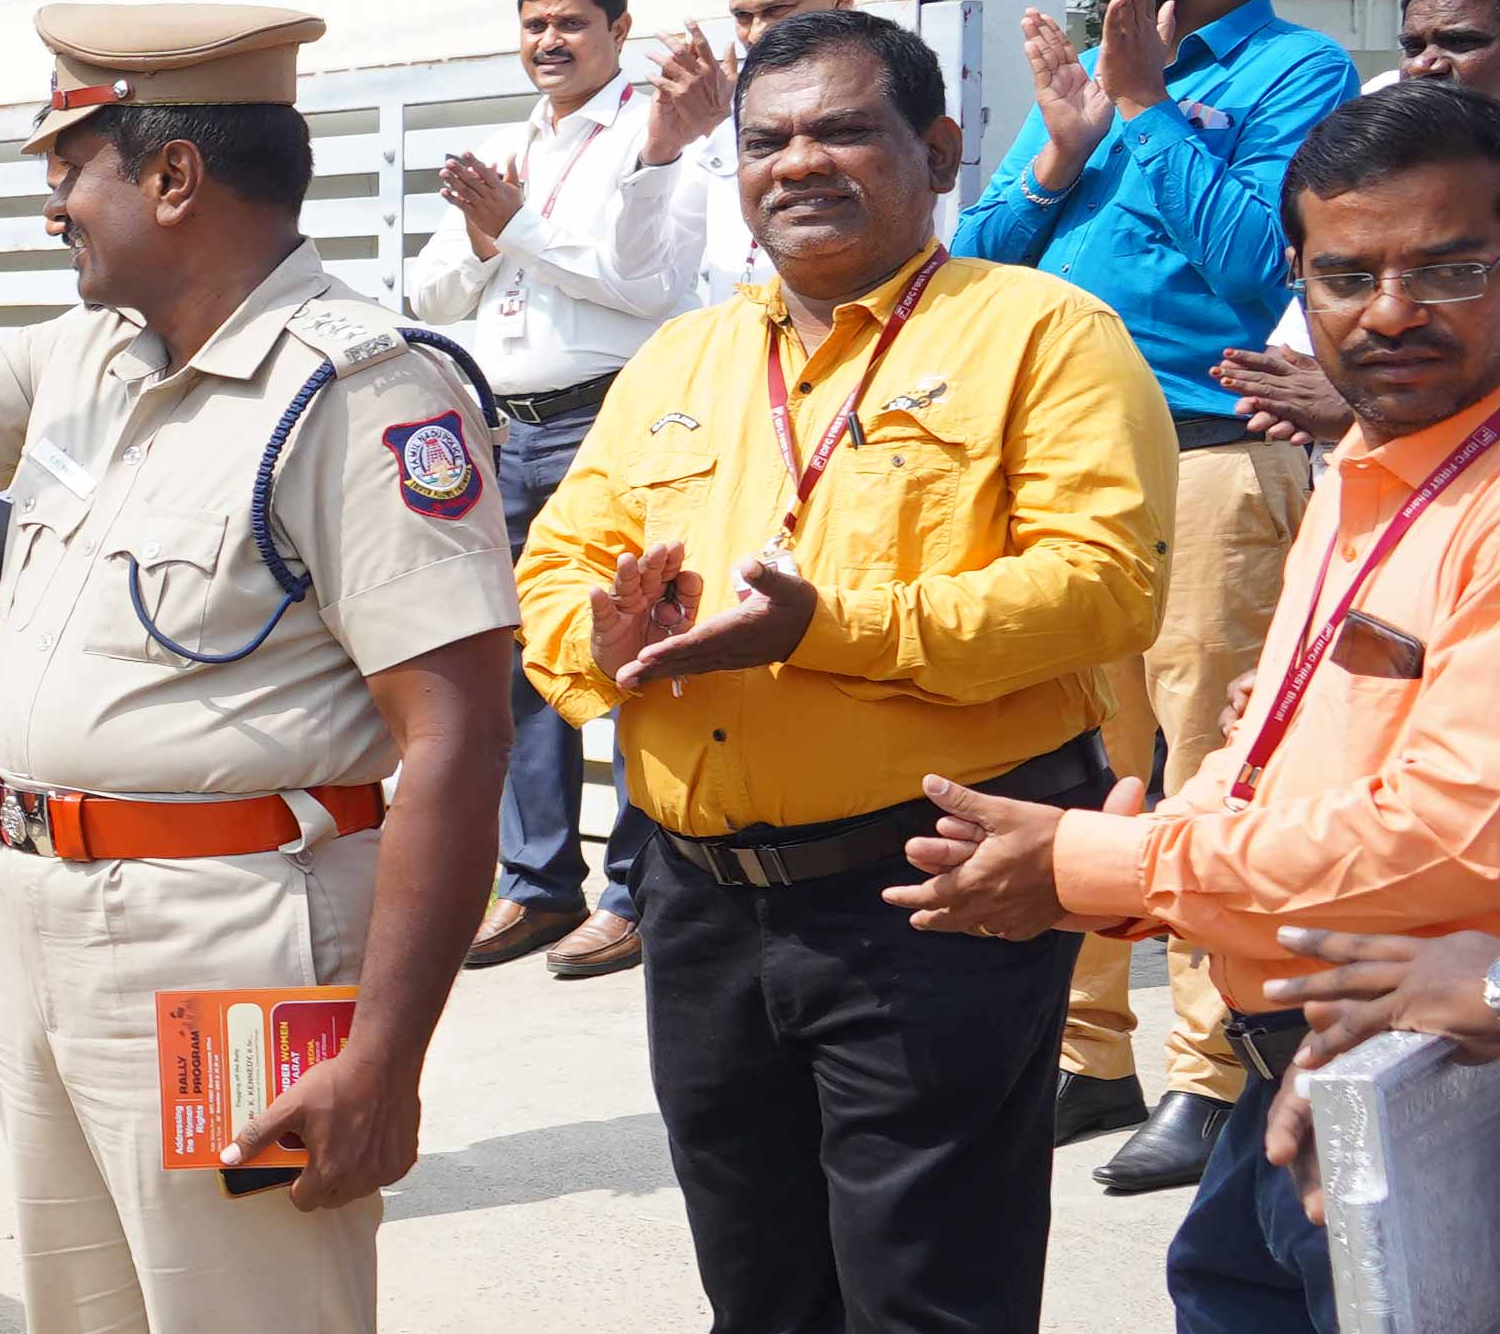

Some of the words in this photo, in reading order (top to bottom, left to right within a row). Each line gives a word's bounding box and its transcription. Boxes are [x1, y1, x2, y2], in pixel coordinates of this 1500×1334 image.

[1454, 441, 1479, 466] IDFC
[1431, 463, 1457, 492] FIRST
[1403, 488, 1433, 518] Bharat
[1291, 662, 1313, 691] FIRST
[1274, 690, 1297, 722] Bharat
[279, 1021, 290, 1062] WOMEN
[177, 1056, 188, 1094] RALLY
[191, 1031, 202, 1094] PROGRAM
[175, 1106, 185, 1154] Addressing
[185, 1105, 193, 1138] Women
